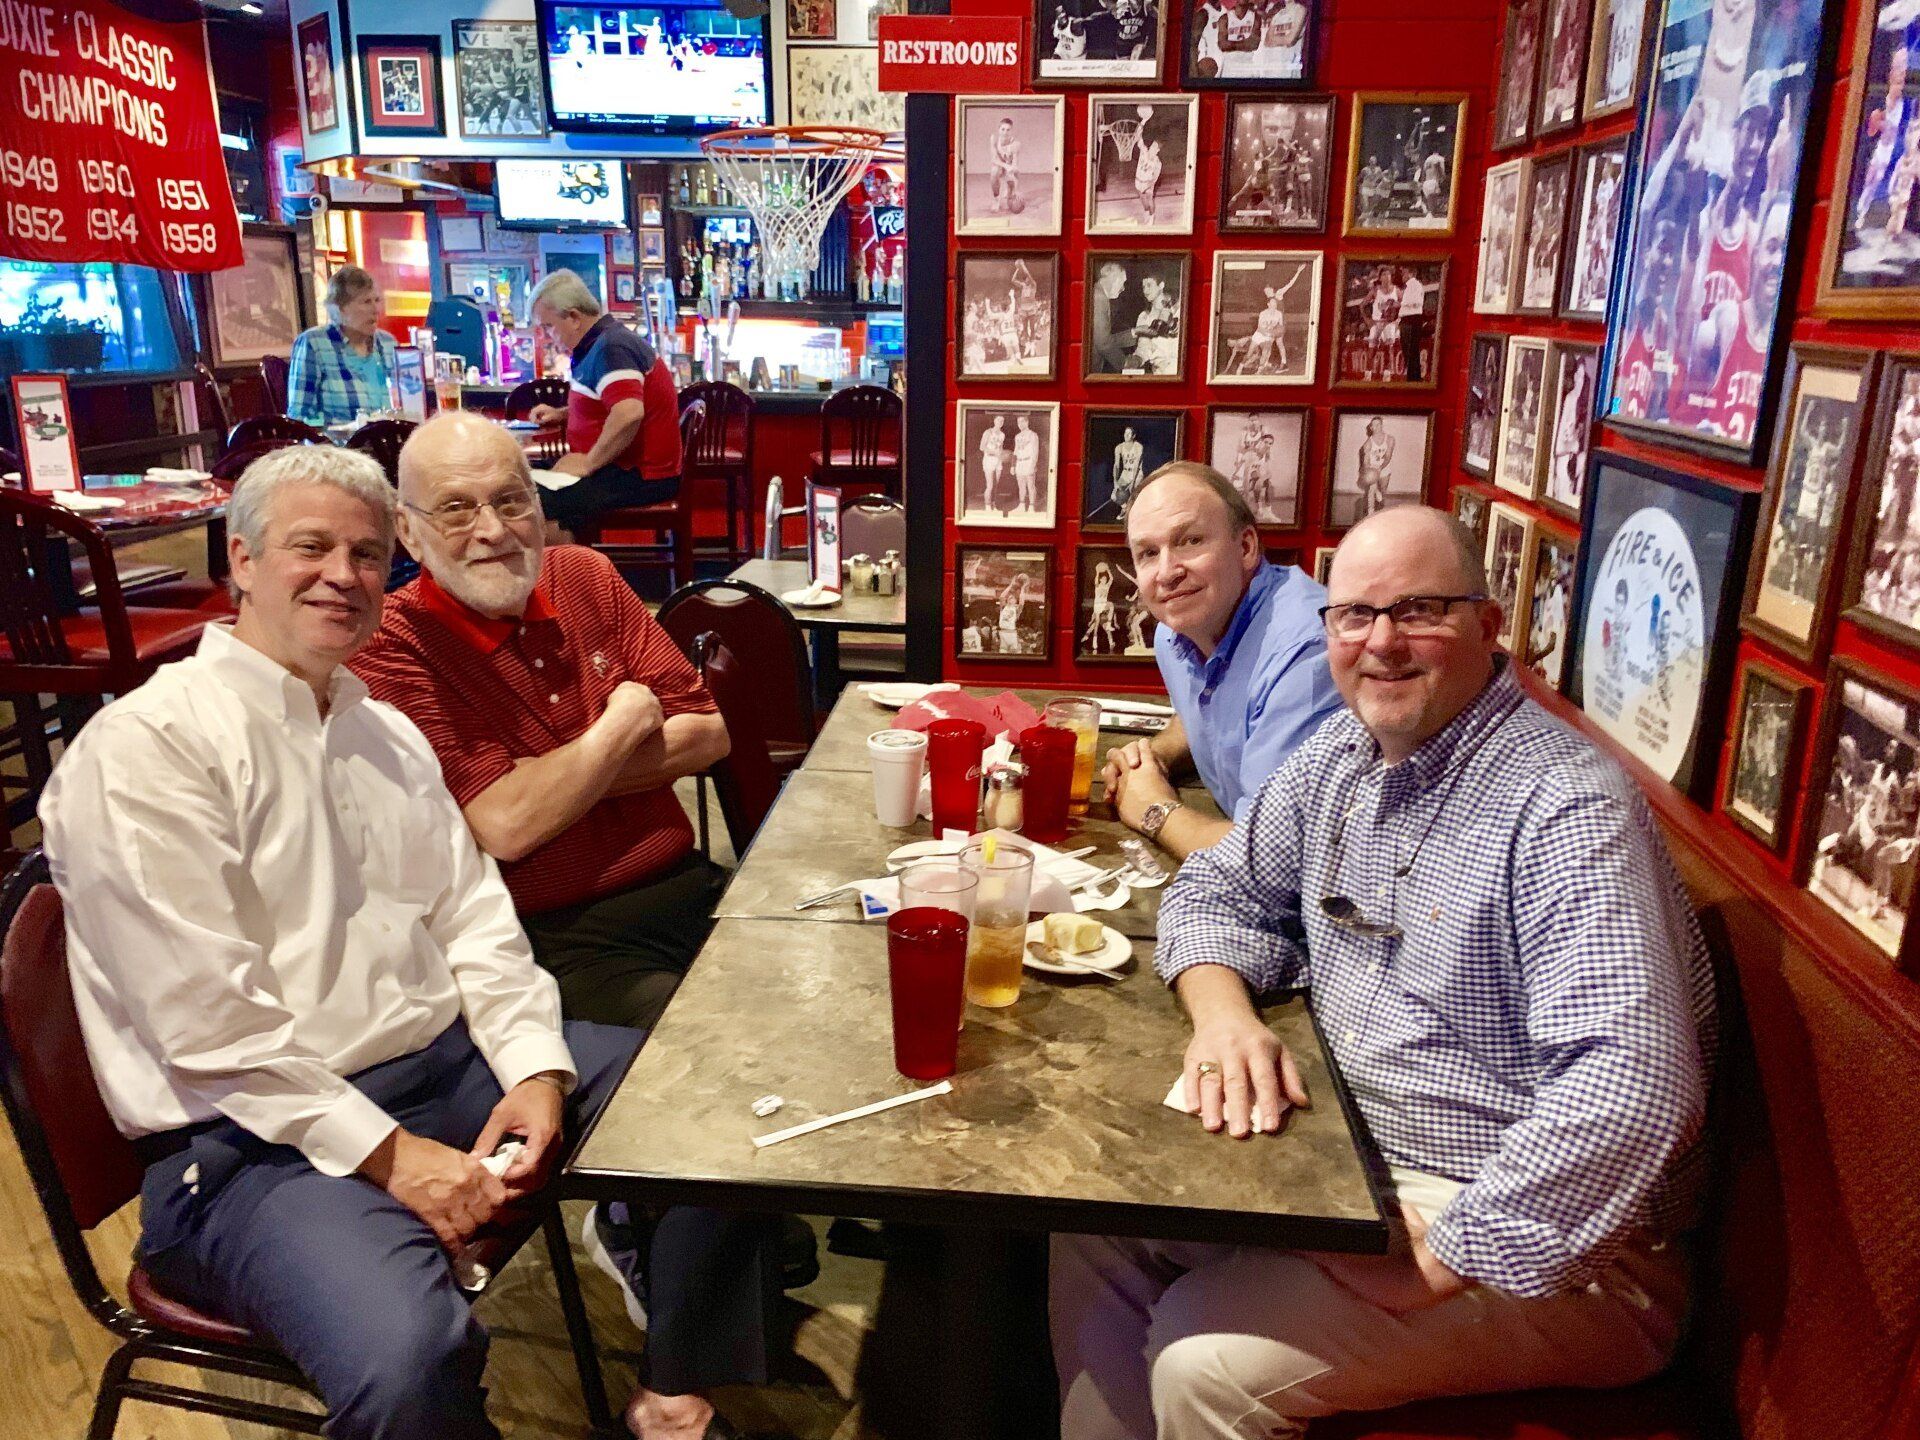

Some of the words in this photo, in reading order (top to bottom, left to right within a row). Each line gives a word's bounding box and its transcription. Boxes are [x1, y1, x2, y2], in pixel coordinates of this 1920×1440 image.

[74, 10, 176, 91] CLASSIC
[883, 40, 1018, 66] RESTROOMS
[19, 69, 168, 147] CHAMPIONS
[0, 150, 58, 192] 1949
[78, 159, 136, 198] 1950
[157, 177, 210, 211] 1951
[7, 201, 67, 243] 1952
[160, 221, 216, 254] 1958
[1607, 530, 1657, 578] FIRE
[1652, 548, 1662, 567] &
[1660, 552, 1696, 615] ICE
